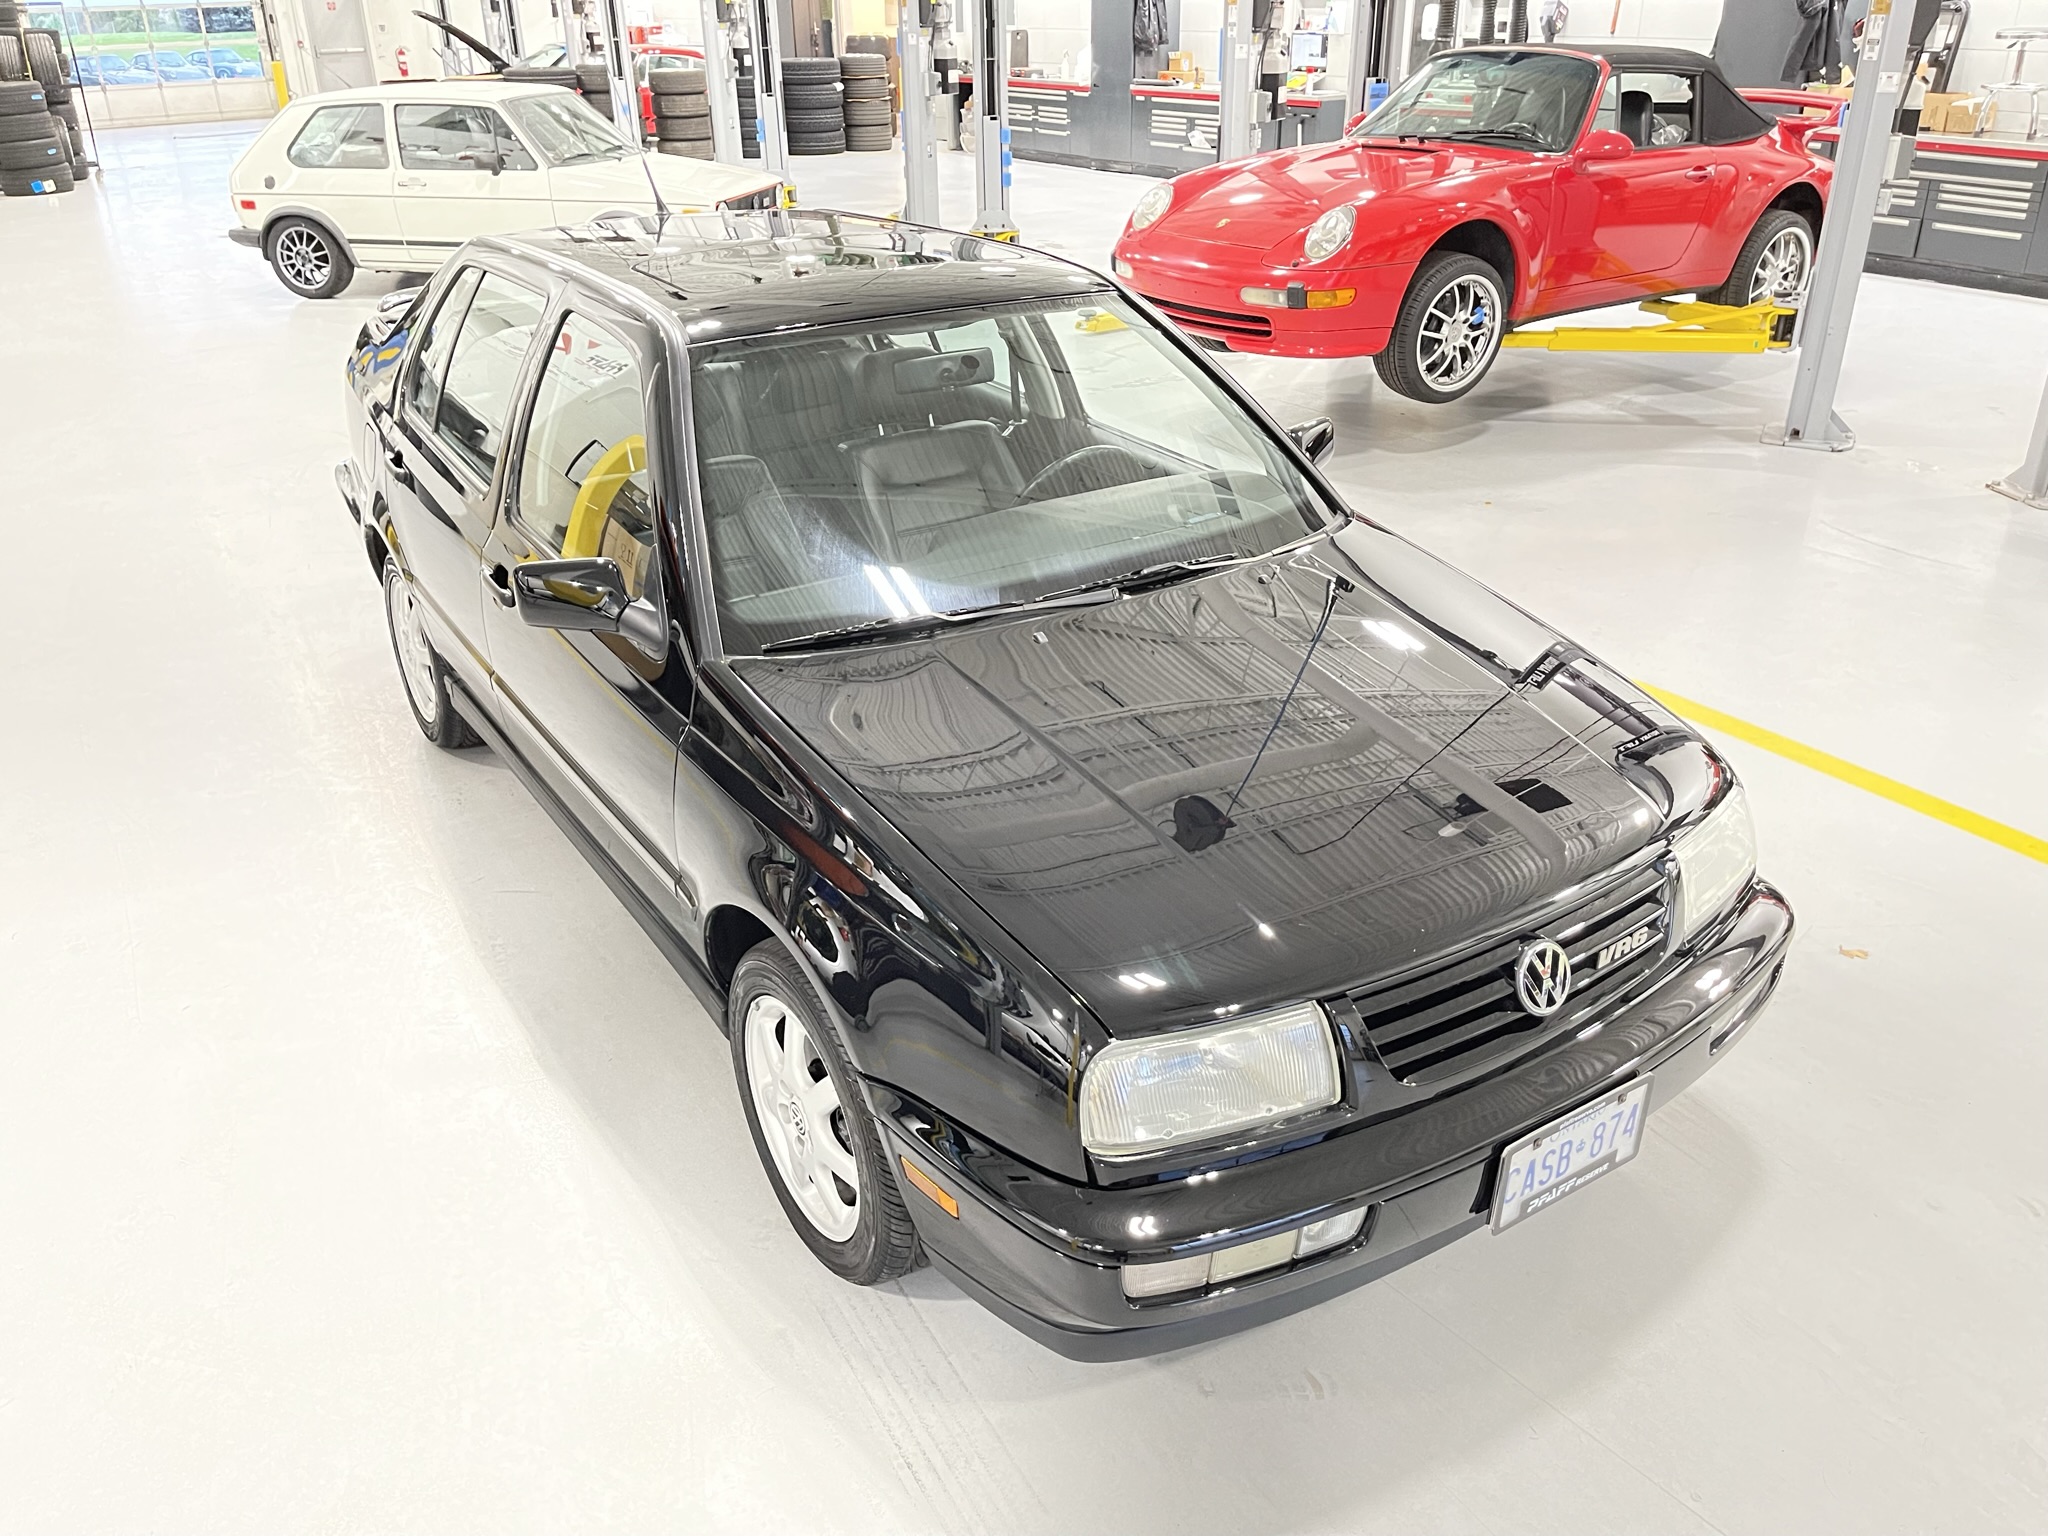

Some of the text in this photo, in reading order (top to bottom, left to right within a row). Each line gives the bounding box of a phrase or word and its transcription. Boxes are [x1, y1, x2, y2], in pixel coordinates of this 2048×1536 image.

[1597, 926, 1649, 969] VR6
[1503, 1103, 1639, 1204] CASB 874
[1527, 1177, 1577, 1213] PFAFF
